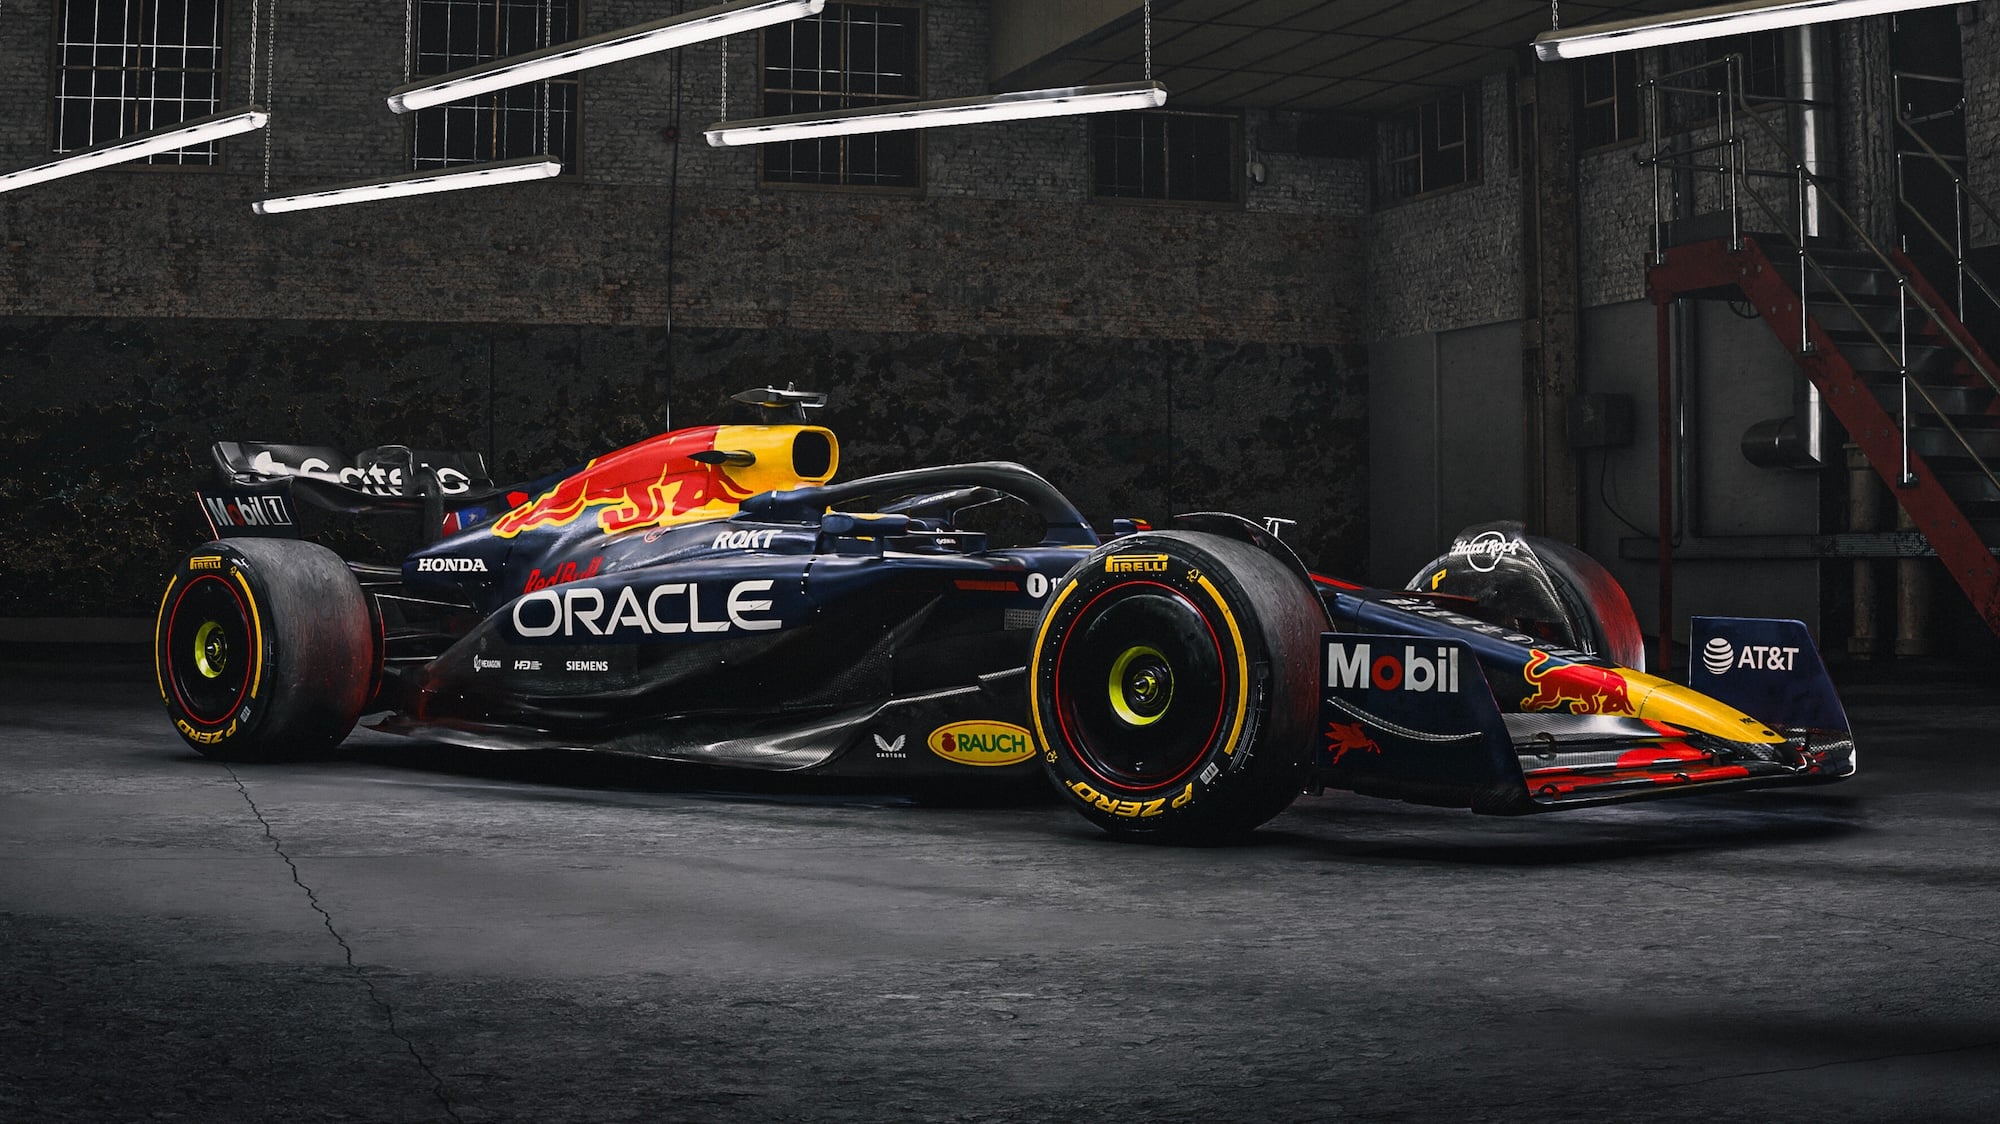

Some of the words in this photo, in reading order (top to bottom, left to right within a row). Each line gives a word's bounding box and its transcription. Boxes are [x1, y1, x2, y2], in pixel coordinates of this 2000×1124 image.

[206, 496, 270, 527] Mobil
[1449, 540, 1489, 556] Hard
[1487, 539, 1520, 559] Rock
[190, 556, 222, 570] PIRELLI
[417, 558, 488, 572] HONDA
[1105, 554, 1169, 573] PIRELLI
[512, 579, 783, 638] ORACLE
[566, 660, 609, 672] SIEMENS
[1327, 642, 1459, 693] Mobil
[1737, 645, 1800, 671] AT&T
[177, 719, 224, 744] ZERO
[225, 718, 238, 737] P
[958, 733, 1026, 753] RAUCH
[1071, 781, 1167, 818] ZERO
[1171, 782, 1194, 809] P
